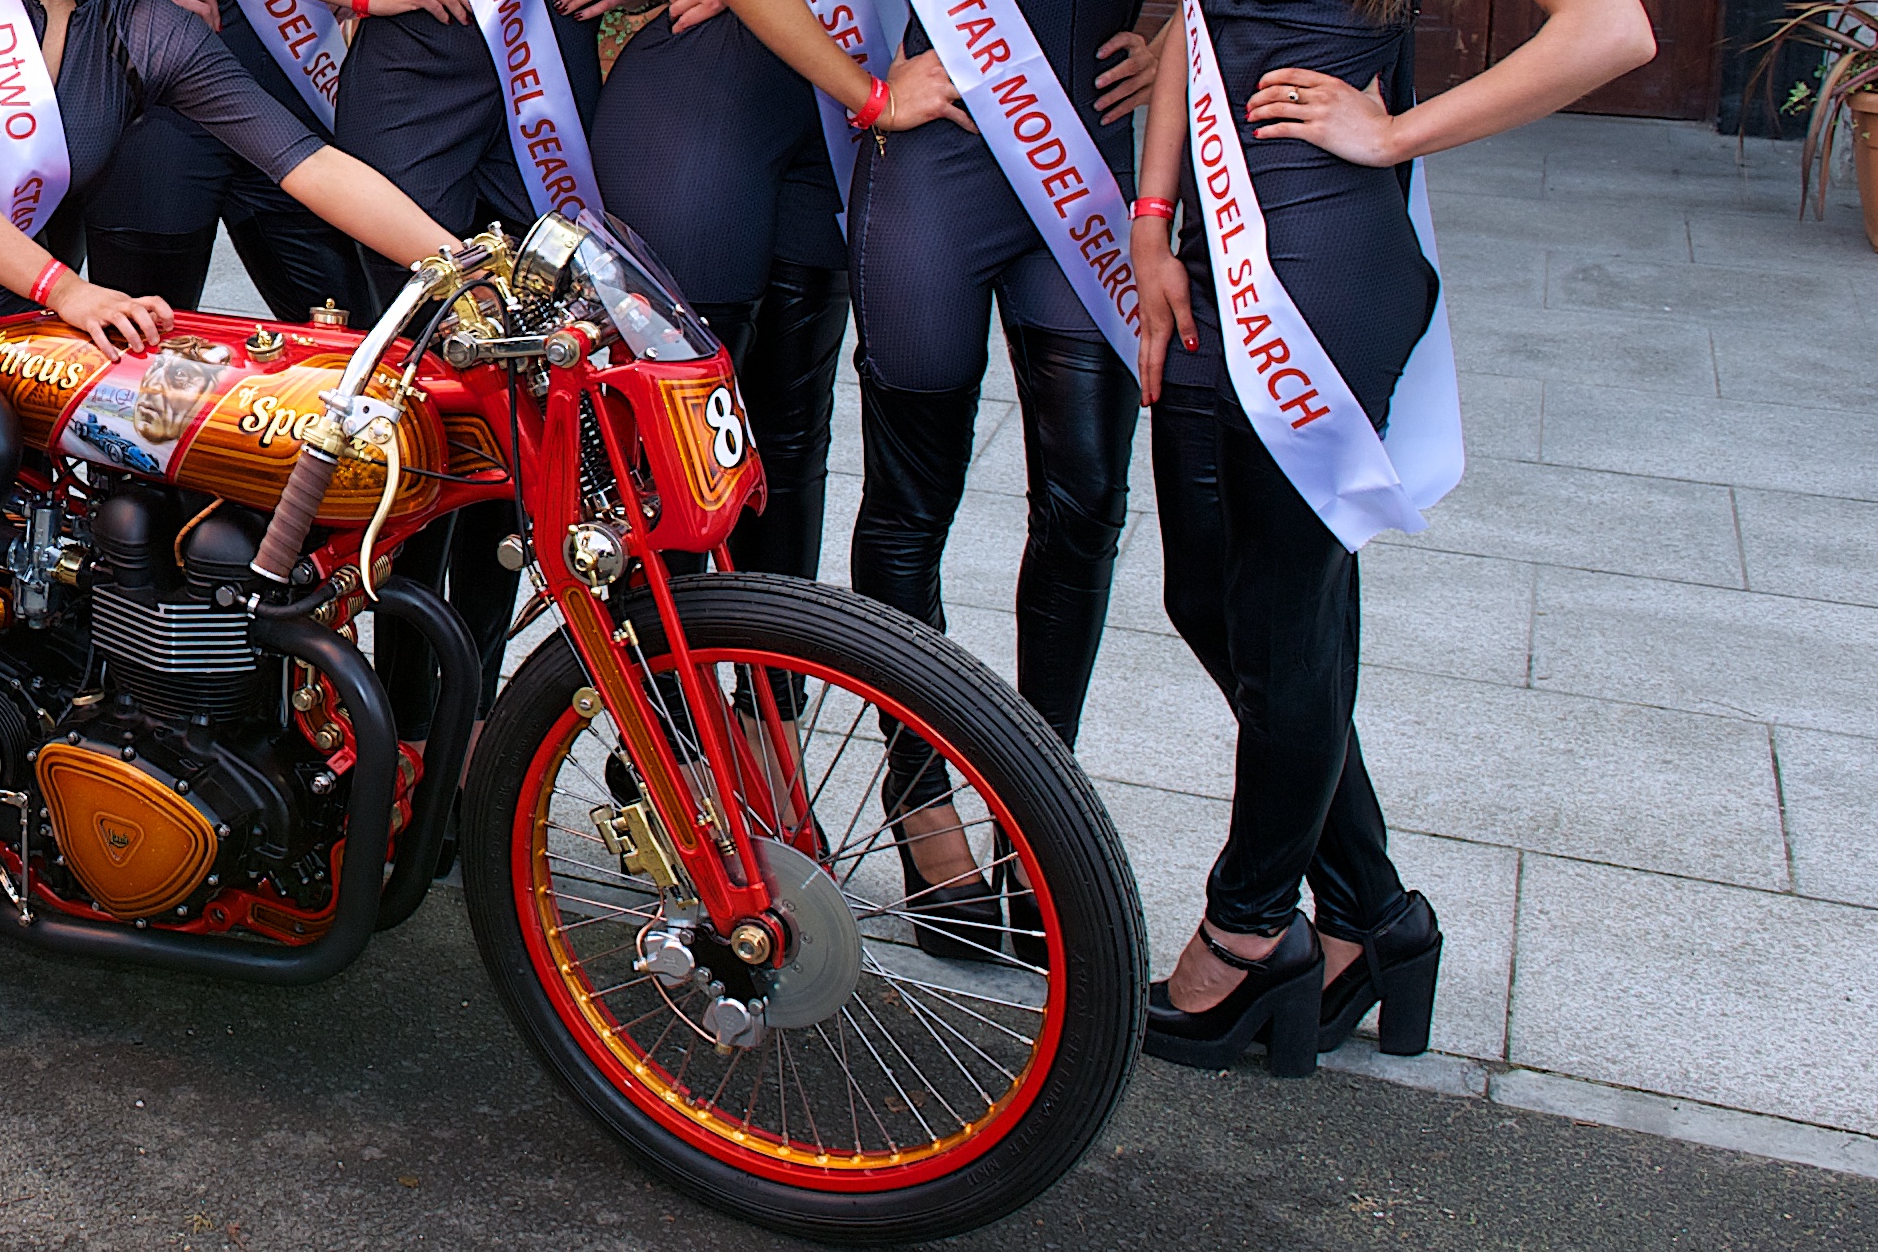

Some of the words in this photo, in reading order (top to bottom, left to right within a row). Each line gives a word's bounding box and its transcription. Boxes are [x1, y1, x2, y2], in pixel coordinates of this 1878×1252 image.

[303, 51, 340, 108] SEA
[520, 119, 587, 221] SEARC
[991, 73, 1090, 220] MODEL
[1194, 92, 1246, 256] MODEL
[1227, 258, 1331, 431] SEARCH
[241, 396, 321, 446] Spe
[705, 375, 757, 468] 8
